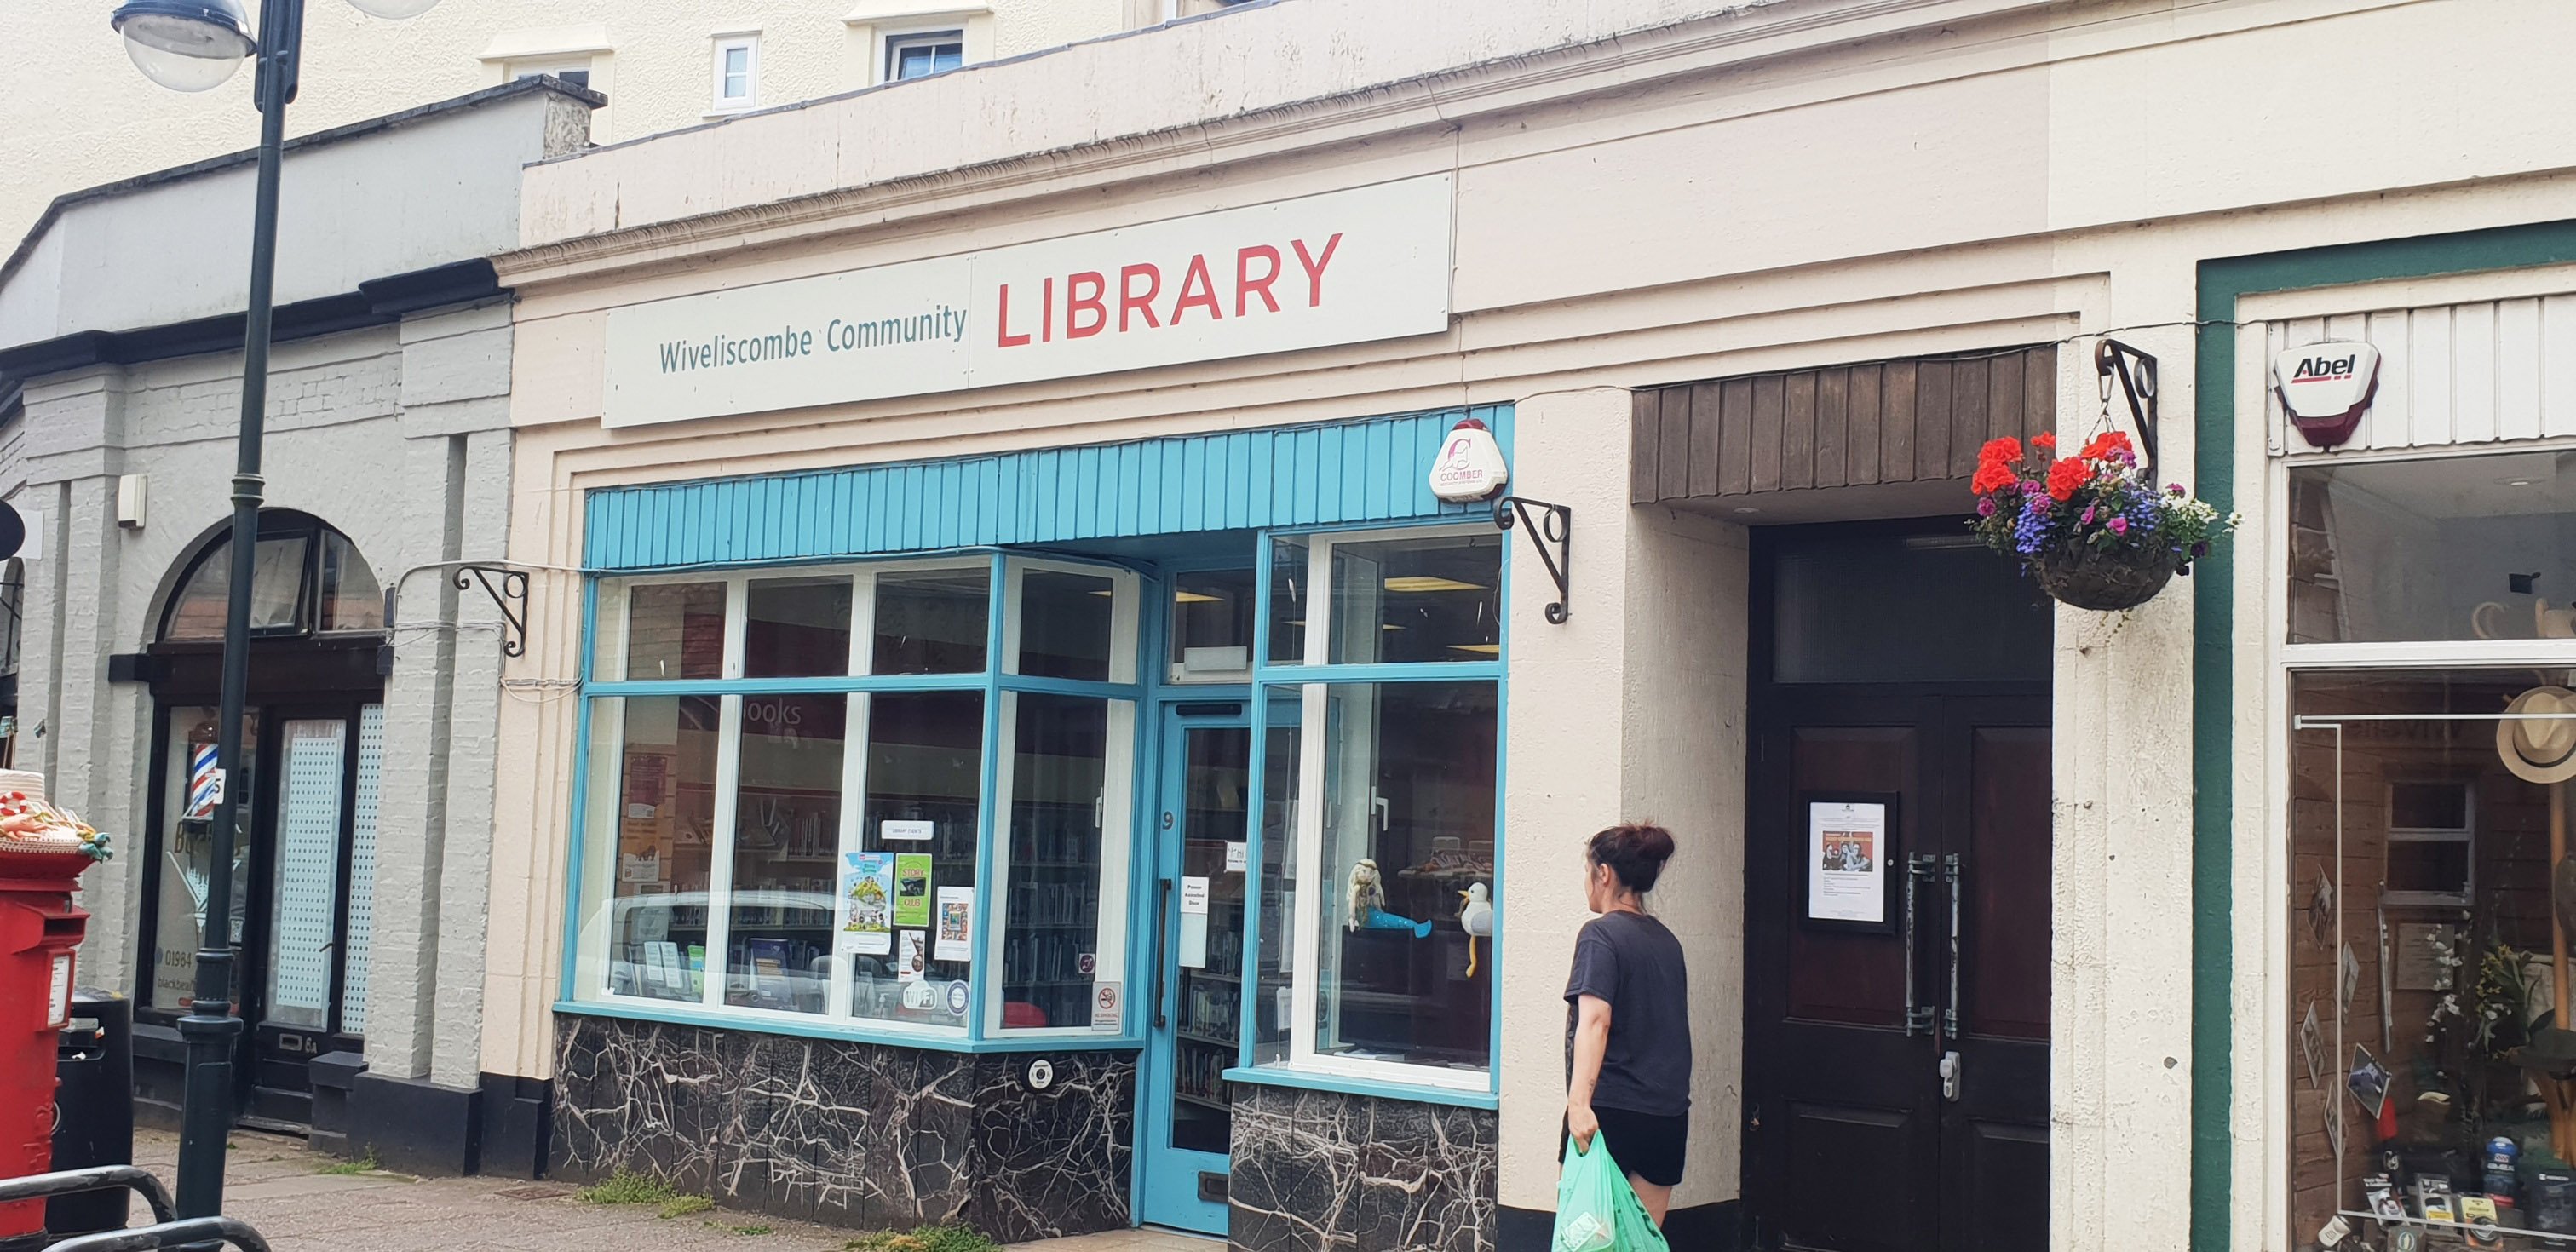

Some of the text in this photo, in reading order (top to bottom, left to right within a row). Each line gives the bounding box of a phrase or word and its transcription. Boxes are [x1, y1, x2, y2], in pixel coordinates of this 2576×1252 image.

[659, 233, 1343, 374] Wiveliscombe Community LIBRARY
[2293, 354, 2355, 378] Abel
[1440, 469, 1483, 482] COOMBER
[744, 697, 802, 725] ooks
[1162, 811, 1174, 830] 9
[165, 950, 192, 968] 01984
